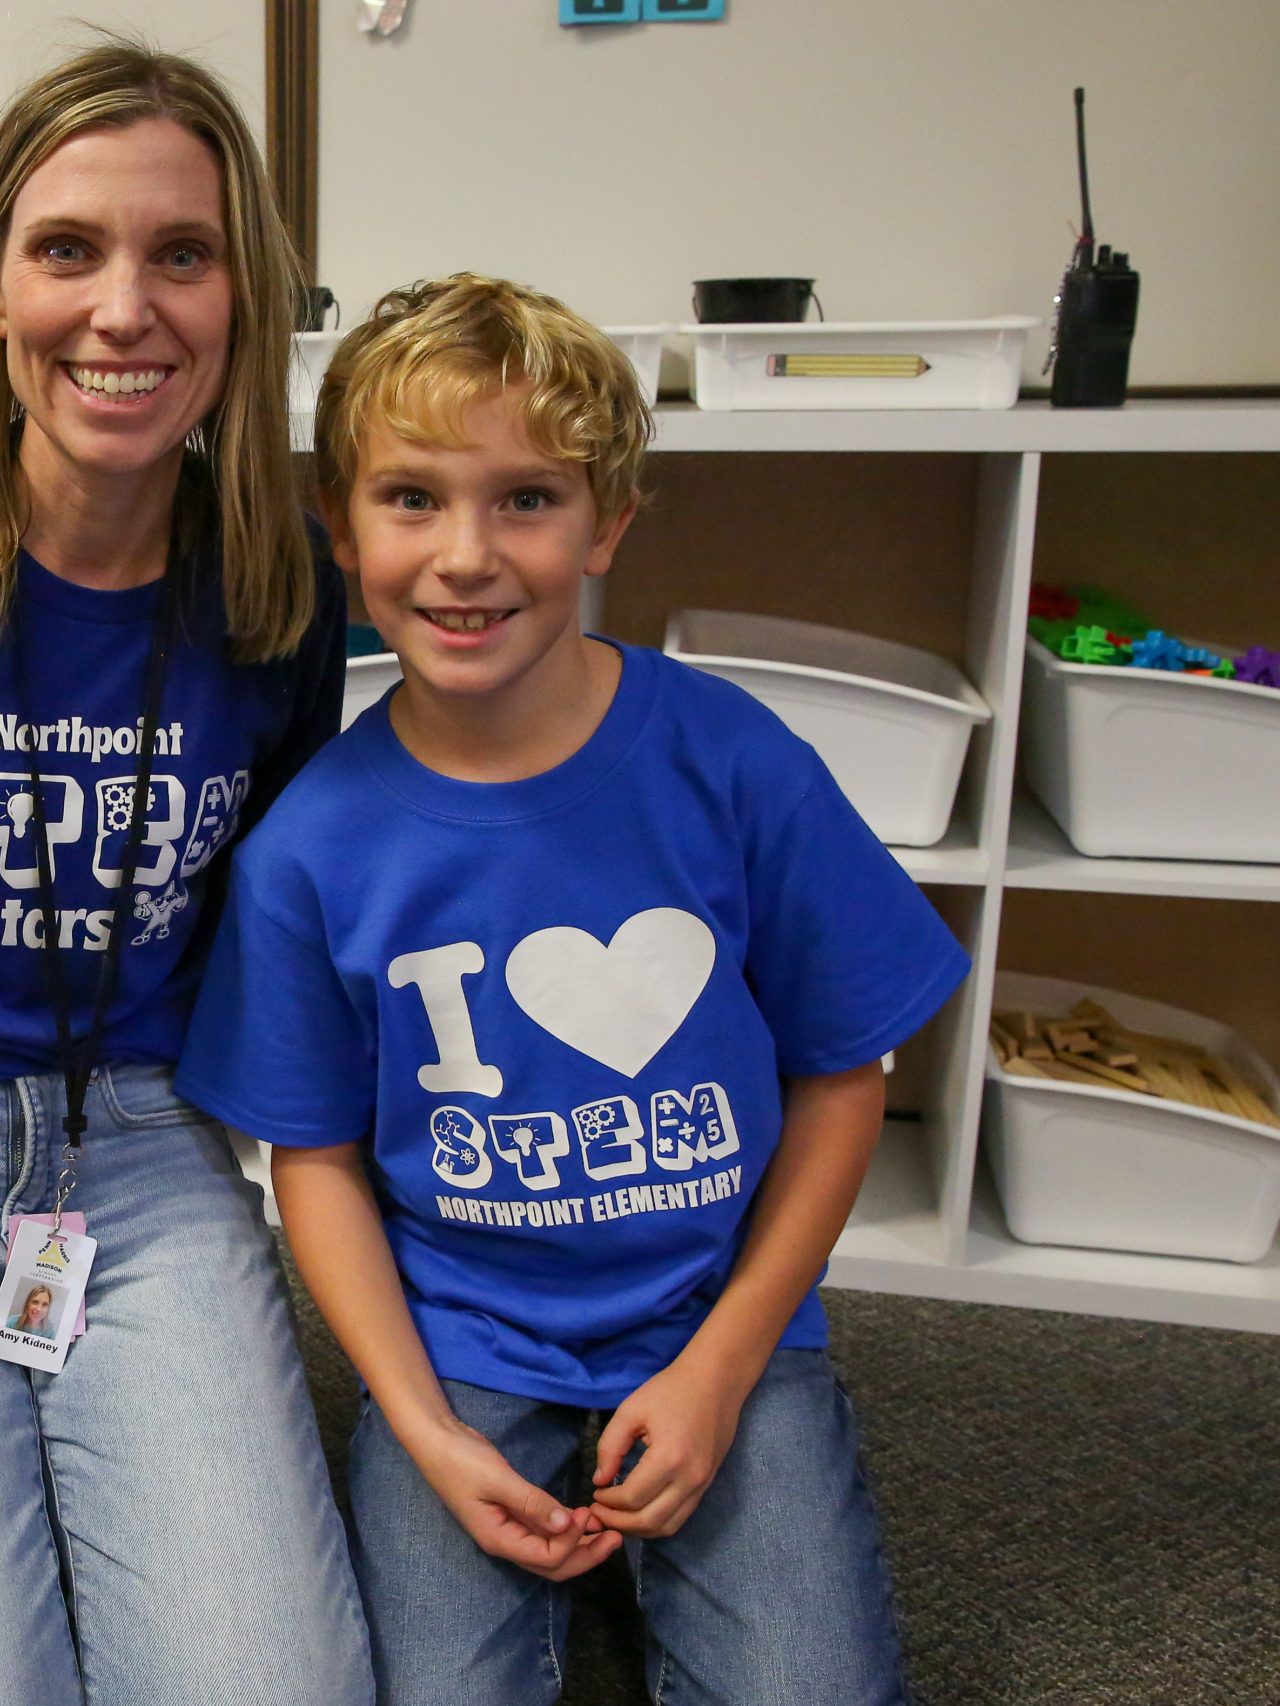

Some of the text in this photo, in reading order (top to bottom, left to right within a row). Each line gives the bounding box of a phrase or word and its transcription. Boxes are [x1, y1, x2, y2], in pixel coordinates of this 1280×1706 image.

[387, 940, 504, 1098] I
[429, 1081, 741, 1191] STEM
[436, 1165, 743, 1227] NORTHPOINT ELEMENTARY
[38, 1240, 52, 1255] PENN
[59, 1243, 71, 1264] HARRIS
[36, 1262, 63, 1274] MADISON
[22, 1335, 58, 1354] Kidney
